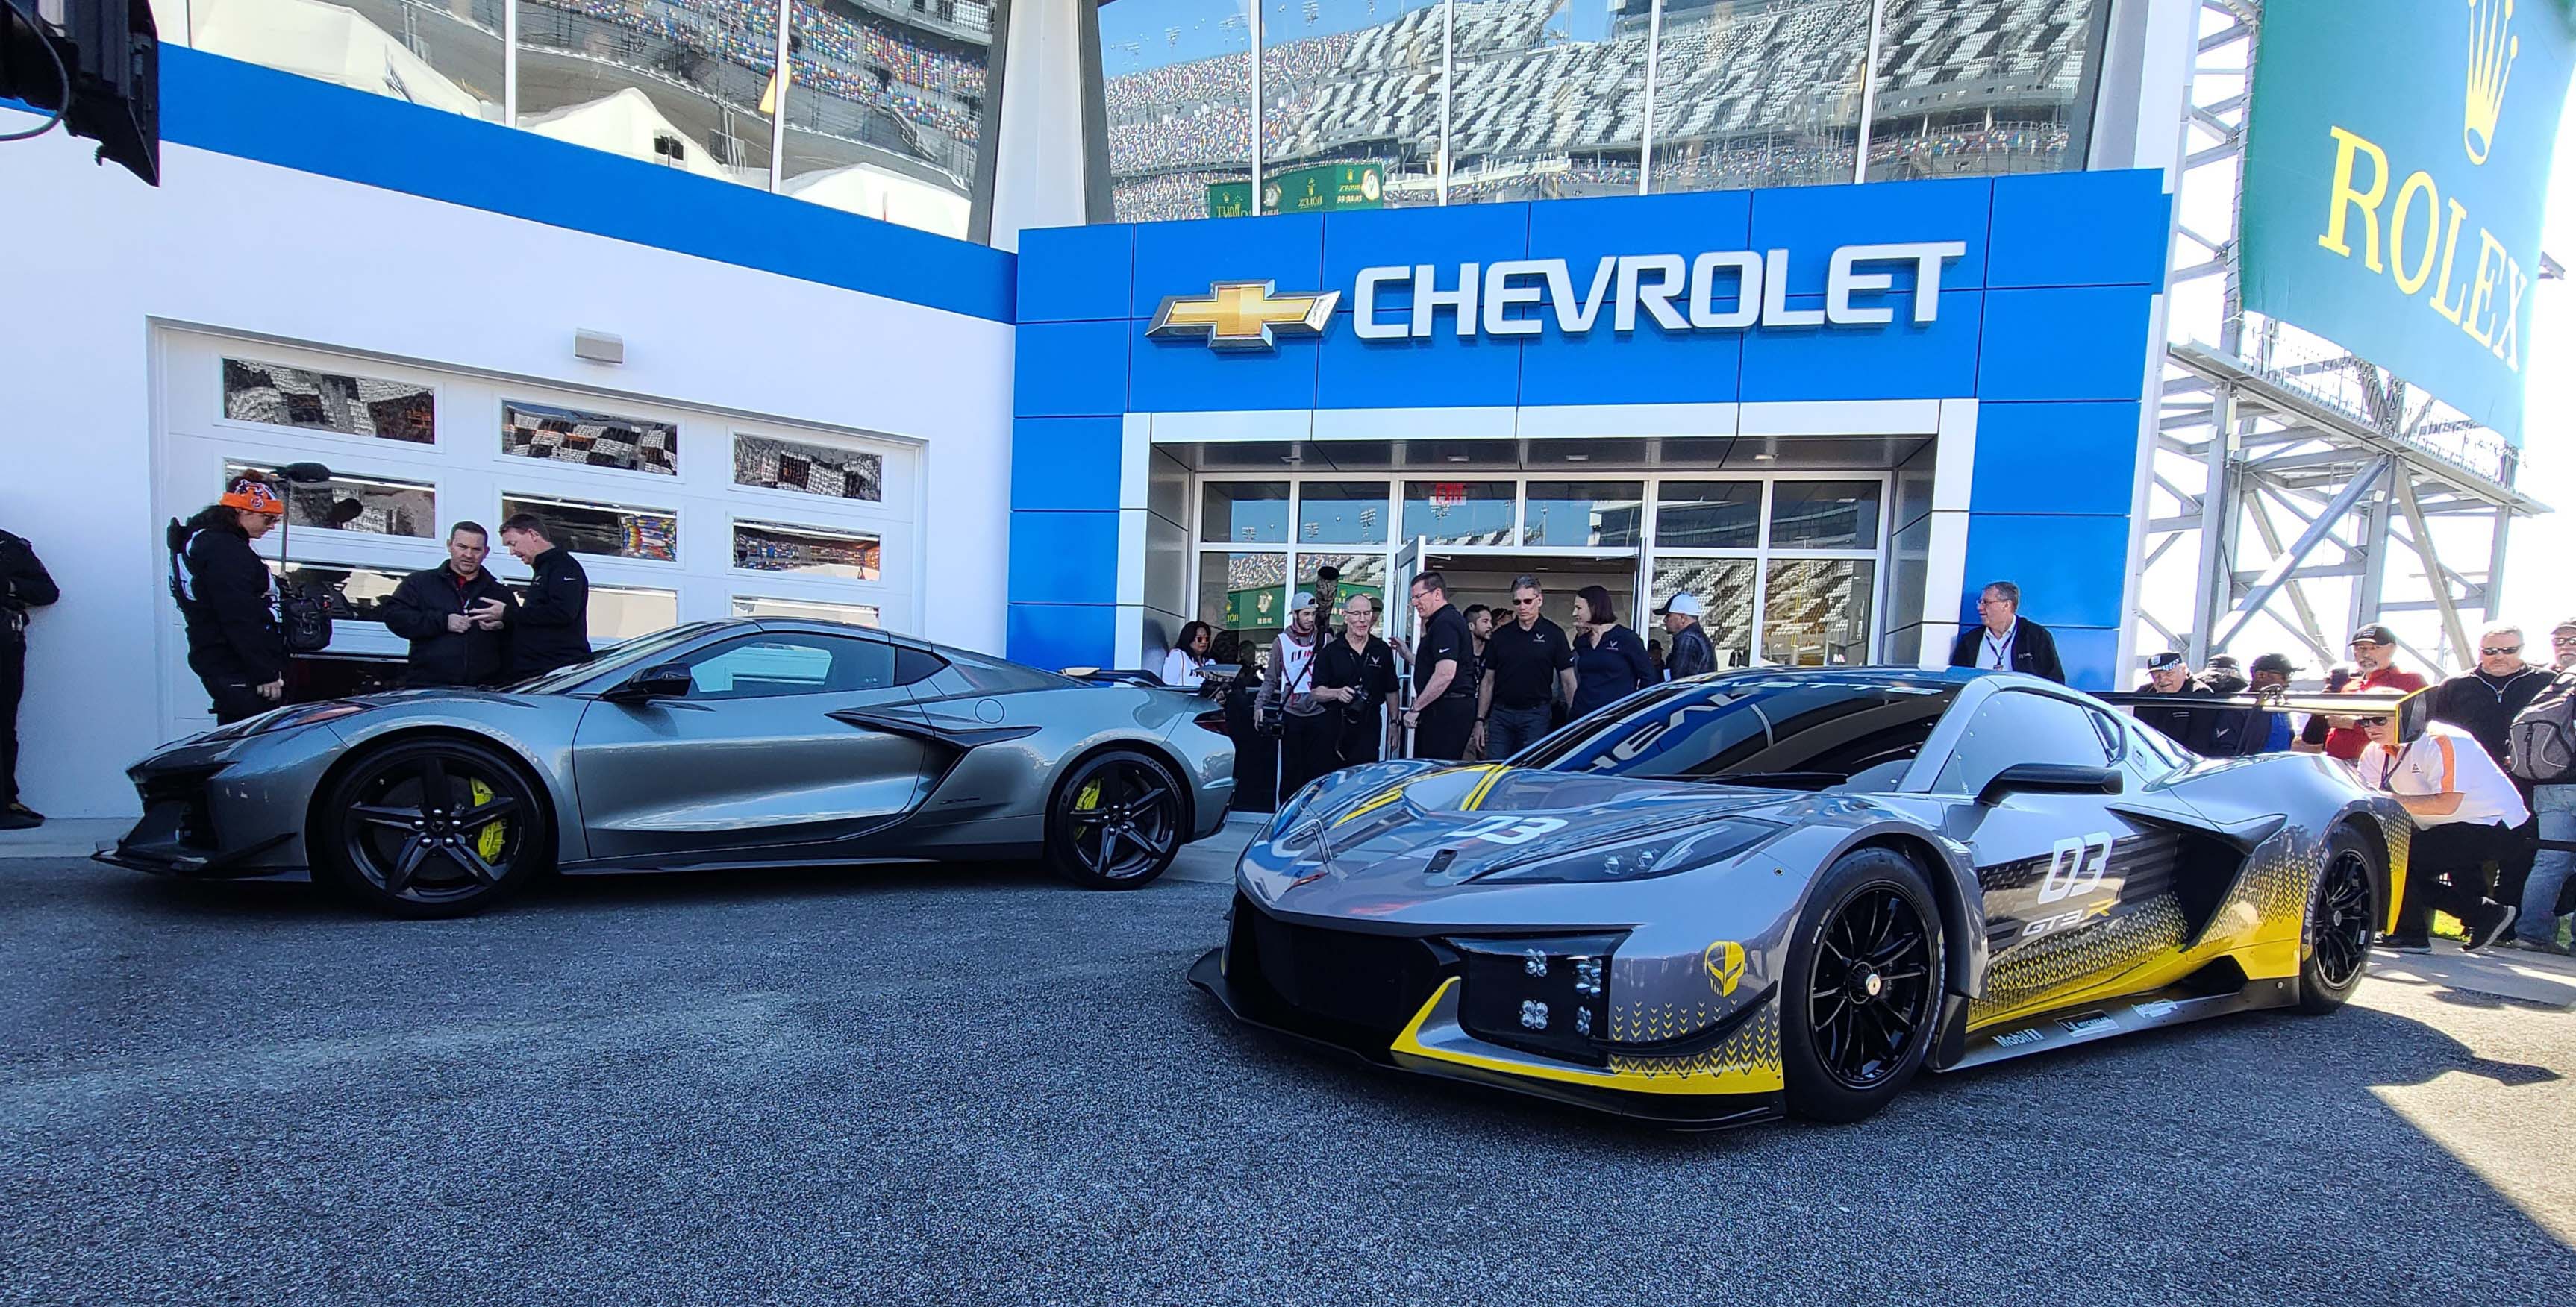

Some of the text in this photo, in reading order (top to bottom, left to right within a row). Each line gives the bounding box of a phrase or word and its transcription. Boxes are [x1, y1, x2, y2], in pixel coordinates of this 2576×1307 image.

[2318, 125, 2527, 372] ROLEX
[1354, 240, 1967, 342] CHEVROLET
[1441, 815, 1569, 844] 03
[2038, 831, 2113, 905] 03
[2304, 847, 2330, 927] MICHELIN
